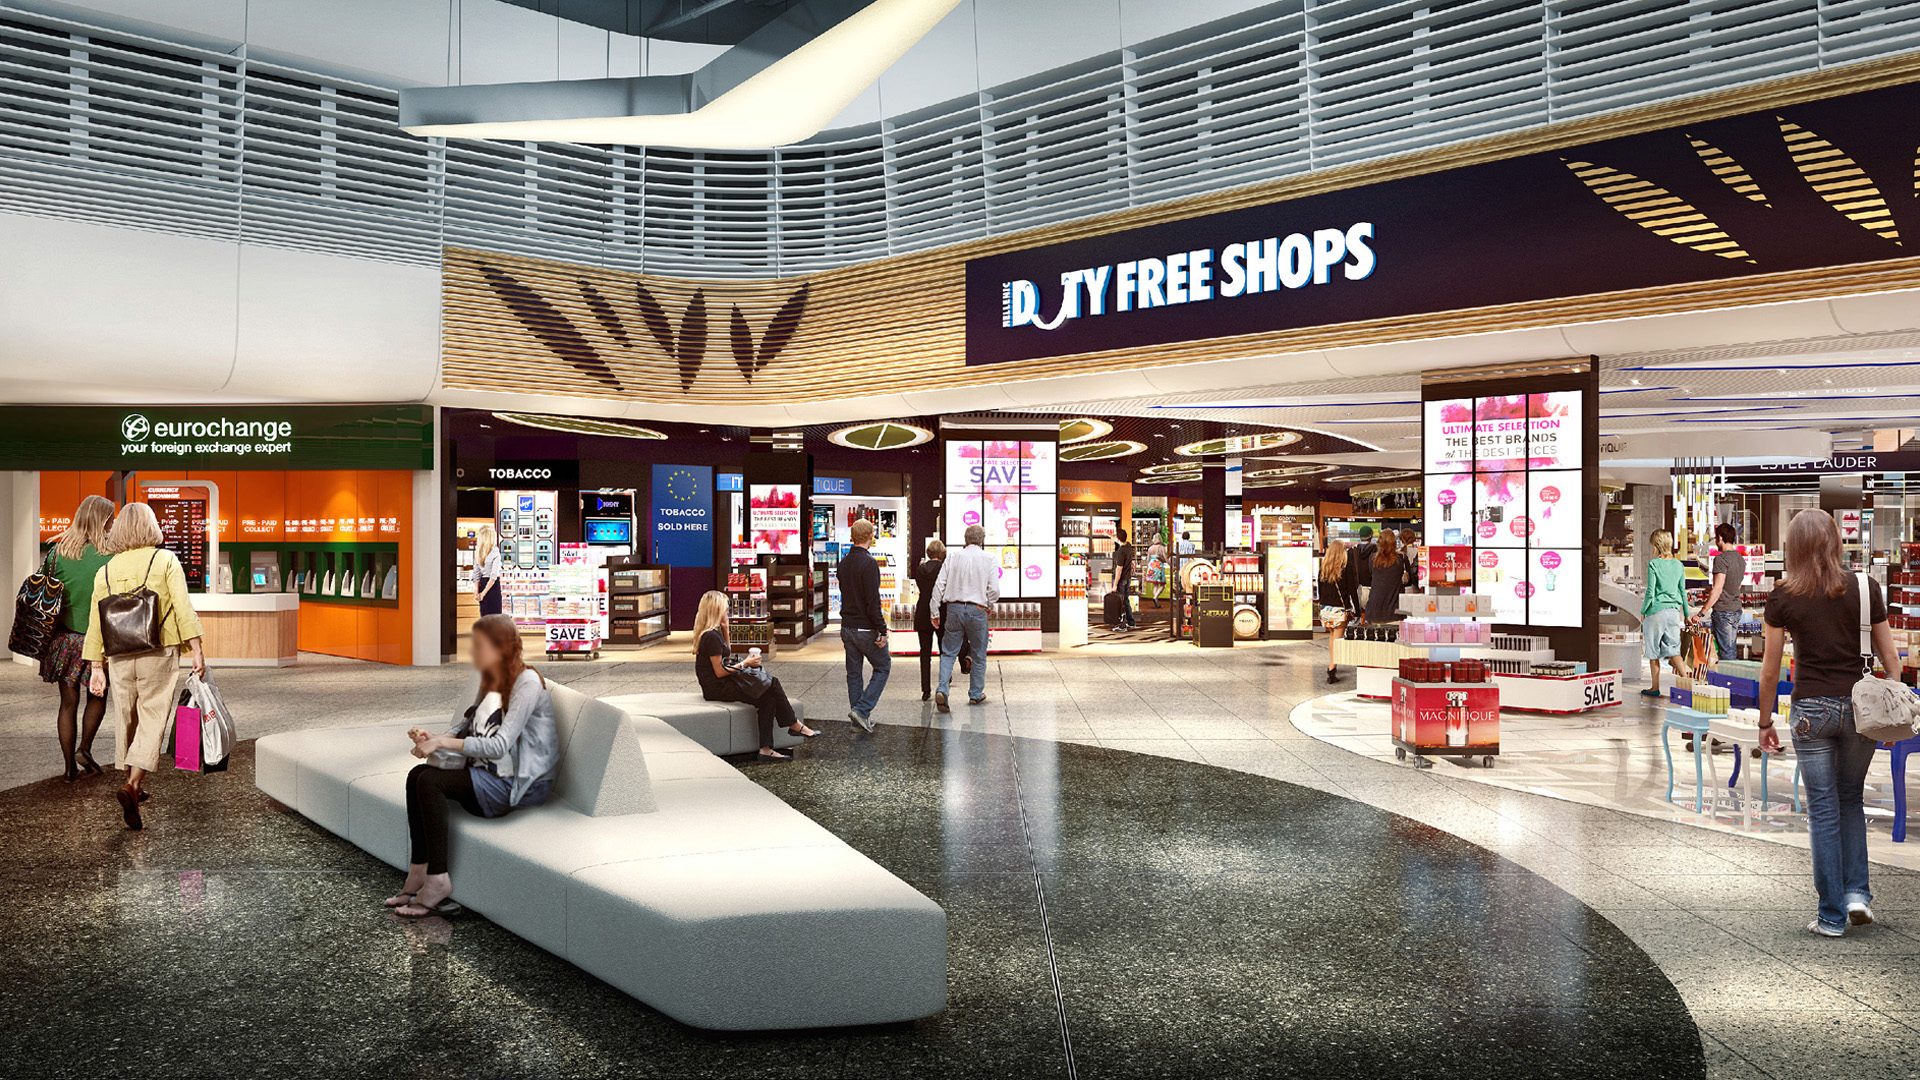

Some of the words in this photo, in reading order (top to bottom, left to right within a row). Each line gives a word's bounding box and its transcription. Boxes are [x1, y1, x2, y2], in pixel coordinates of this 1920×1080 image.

[1012, 265, 1112, 330] DUTY
[1116, 248, 1214, 312] FREE
[1220, 222, 1377, 298] SHOPS
[1002, 281, 1012, 328] HELLENIC
[154, 417, 292, 442] eurochange
[1442, 423, 1494, 435] ULTIMATE
[1498, 419, 1561, 432] SELECTION
[1445, 437, 1468, 447] THE
[1505, 432, 1557, 445] BRANDS
[121, 442, 148, 456] your
[150, 441, 192, 456] foreign
[194, 441, 252, 456] exchange
[254, 441, 292, 456] expert
[1813, 456, 1877, 469] LAUDER
[488, 468, 552, 479] TOBACCO
[969, 465, 1032, 484] SAVE
[660, 508, 706, 517] TOBACCO
[658, 522, 682, 531] SOLD
[684, 523, 708, 531] HERE
[550, 628, 586, 640] SAVE
[1584, 682, 1615, 706] SAVE
[1419, 710, 1496, 722] MAGNIFIQUE
